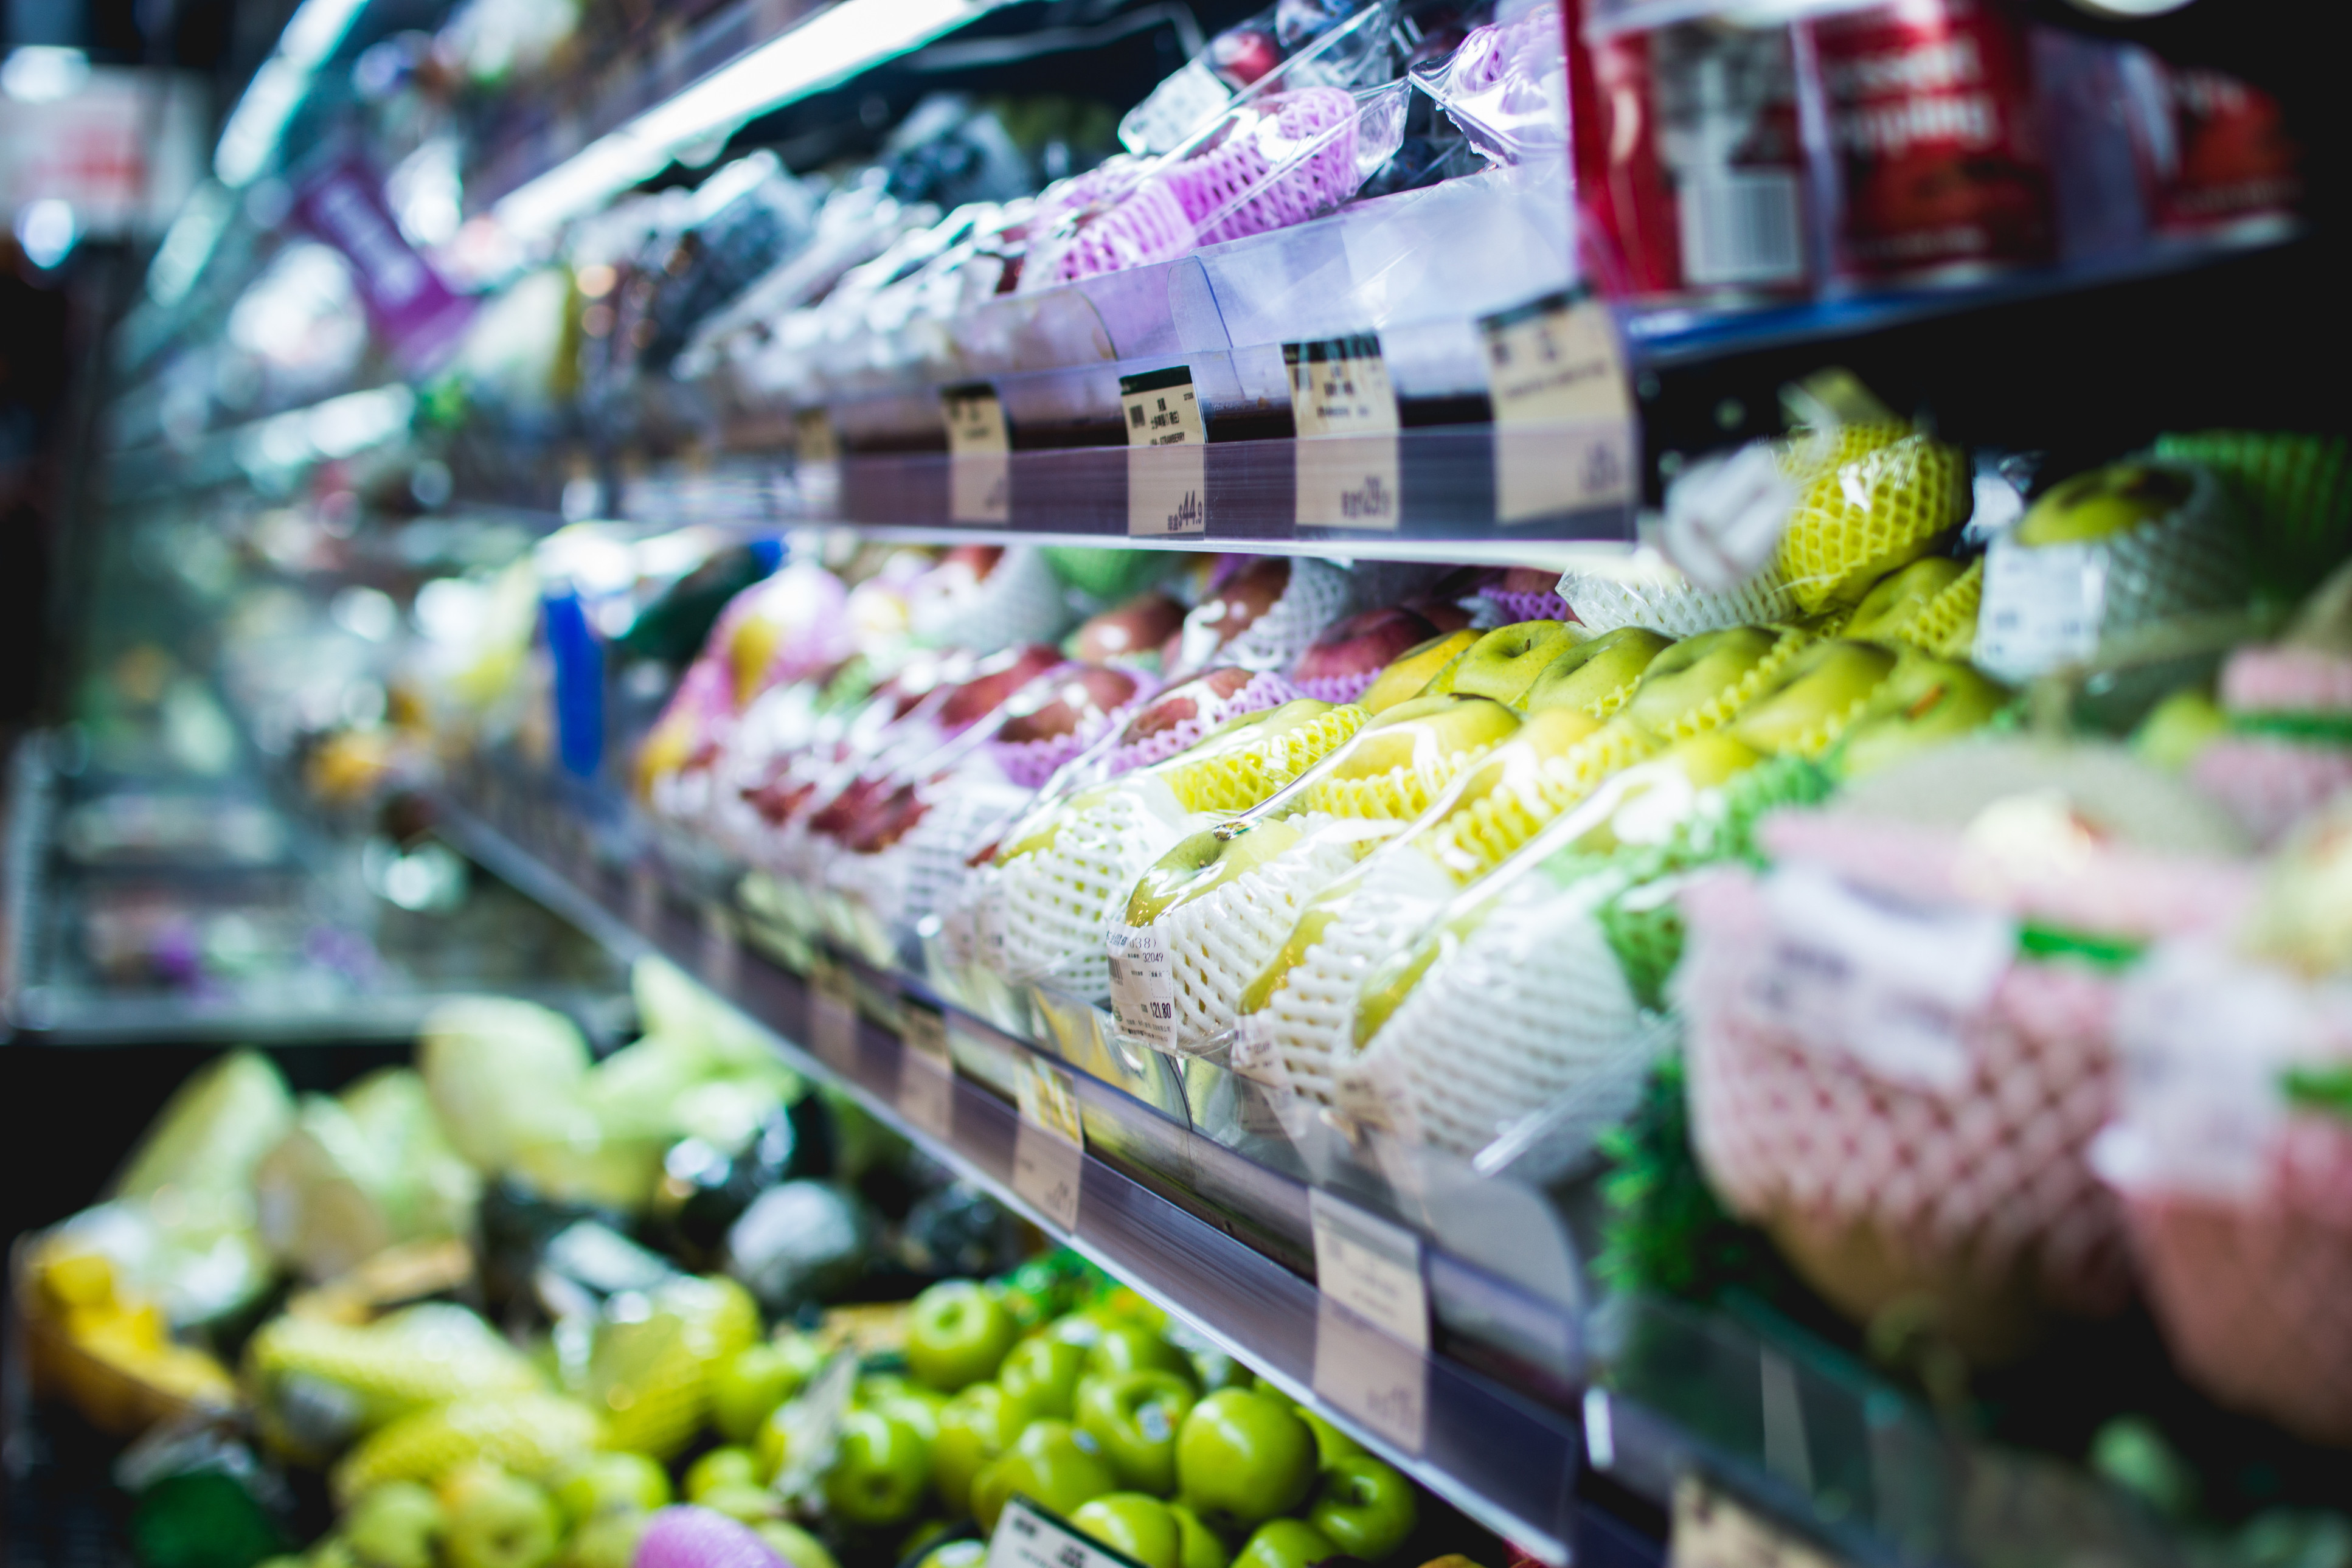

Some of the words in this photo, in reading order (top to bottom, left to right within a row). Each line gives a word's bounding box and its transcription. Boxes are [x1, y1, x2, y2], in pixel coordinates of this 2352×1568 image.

[1160, 431, 1185, 445] STRAWBERRY
[1178, 489, 1202, 531] $44.9
[1142, 952, 1164, 963] 32049
